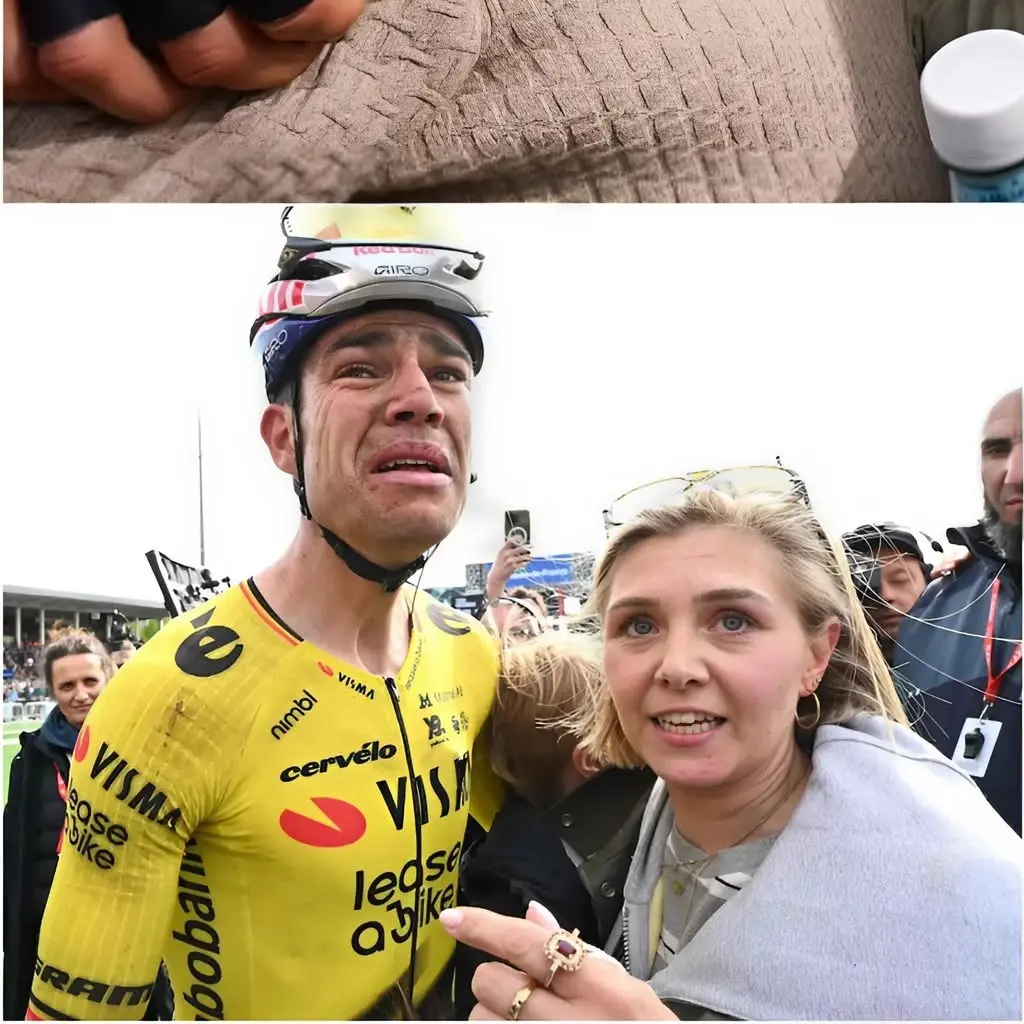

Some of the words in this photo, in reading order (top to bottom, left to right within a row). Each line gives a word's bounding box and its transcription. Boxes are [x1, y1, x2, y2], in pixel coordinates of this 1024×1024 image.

[374, 265, 429, 276] GIRO
[338, 671, 375, 700] VISMA
[270, 689, 318, 741] nimbl
[280, 741, 396, 783] cervélo
[90, 741, 182, 831] VISMA
[354, 841, 461, 910] lease
